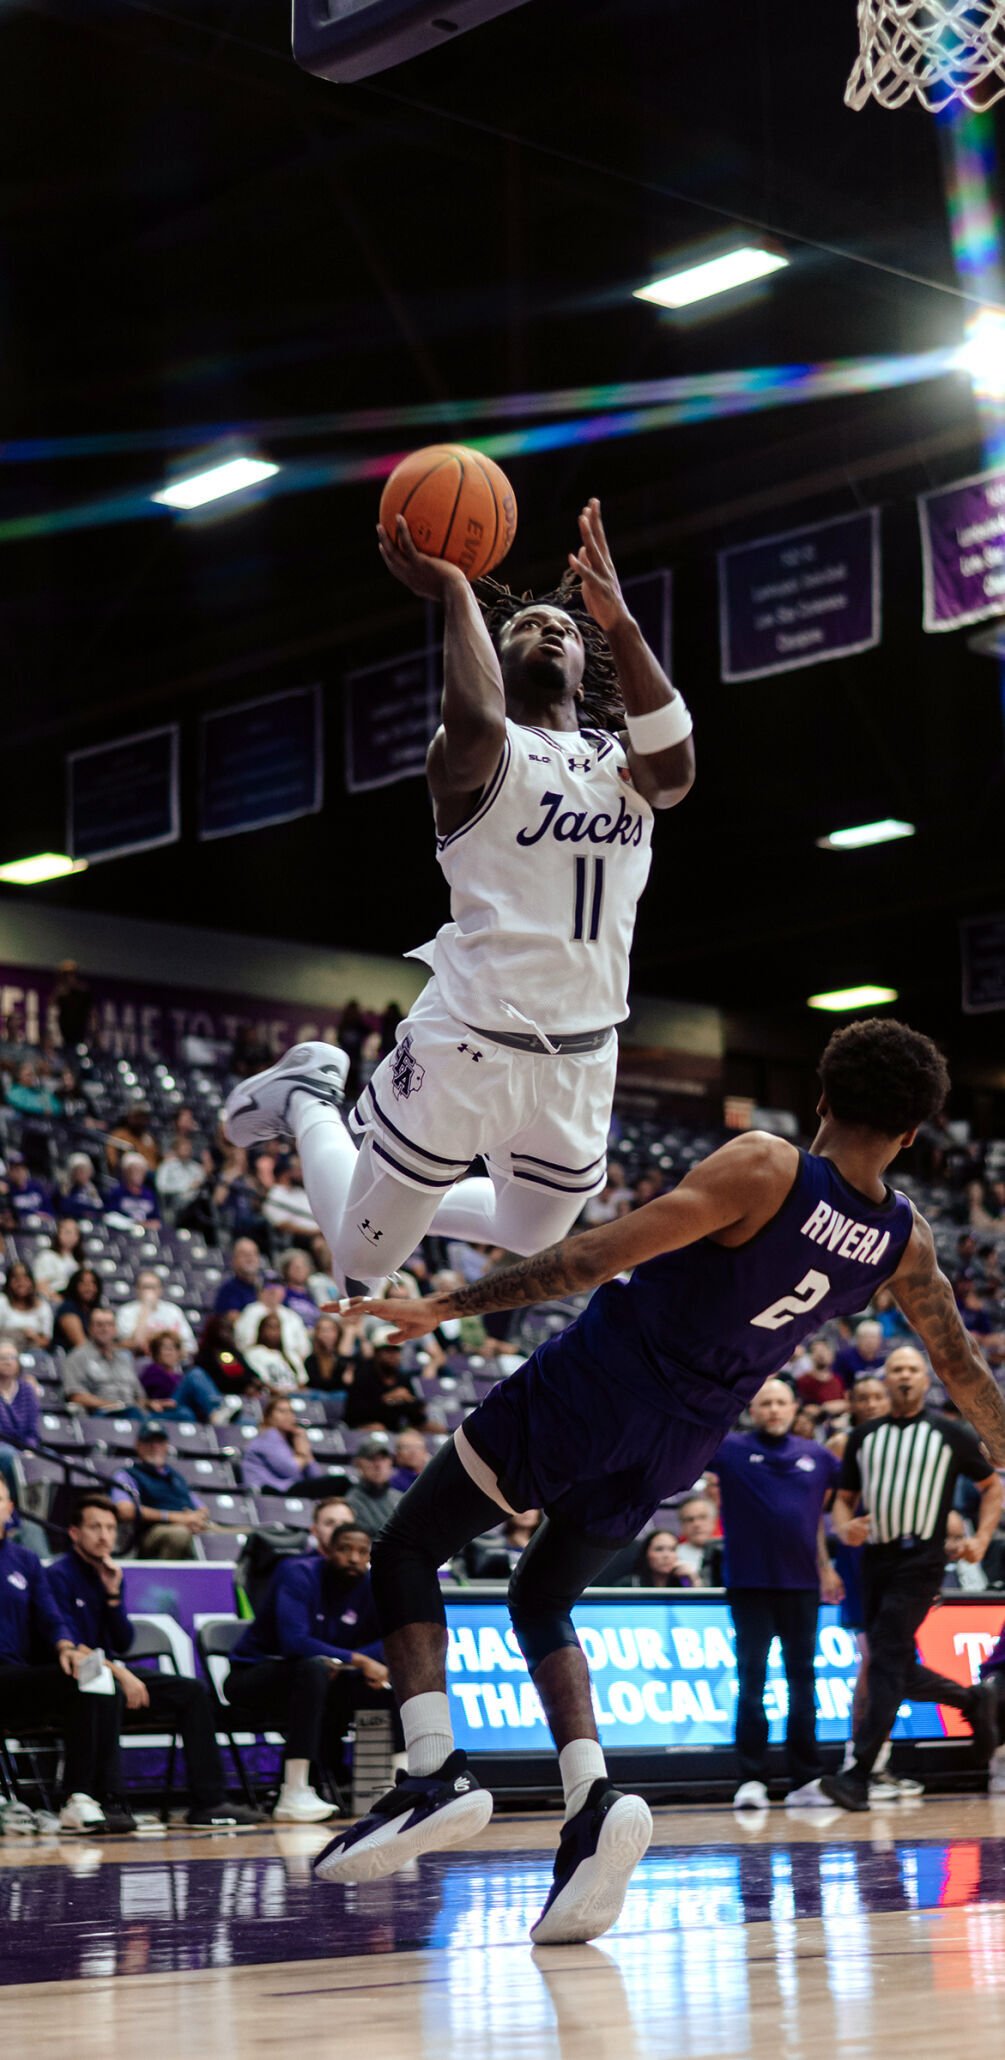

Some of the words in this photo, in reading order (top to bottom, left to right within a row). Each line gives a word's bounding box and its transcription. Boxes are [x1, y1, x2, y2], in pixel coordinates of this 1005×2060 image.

[516, 791, 643, 847] Jacks
[570, 854, 605, 943] 11
[800, 1200, 891, 1266] RIVERA
[749, 1268, 831, 1331] 2
[575, 1626, 673, 1671] OUR
[451, 1681, 548, 1729] THA
[591, 1679, 728, 1725] LOCAL
